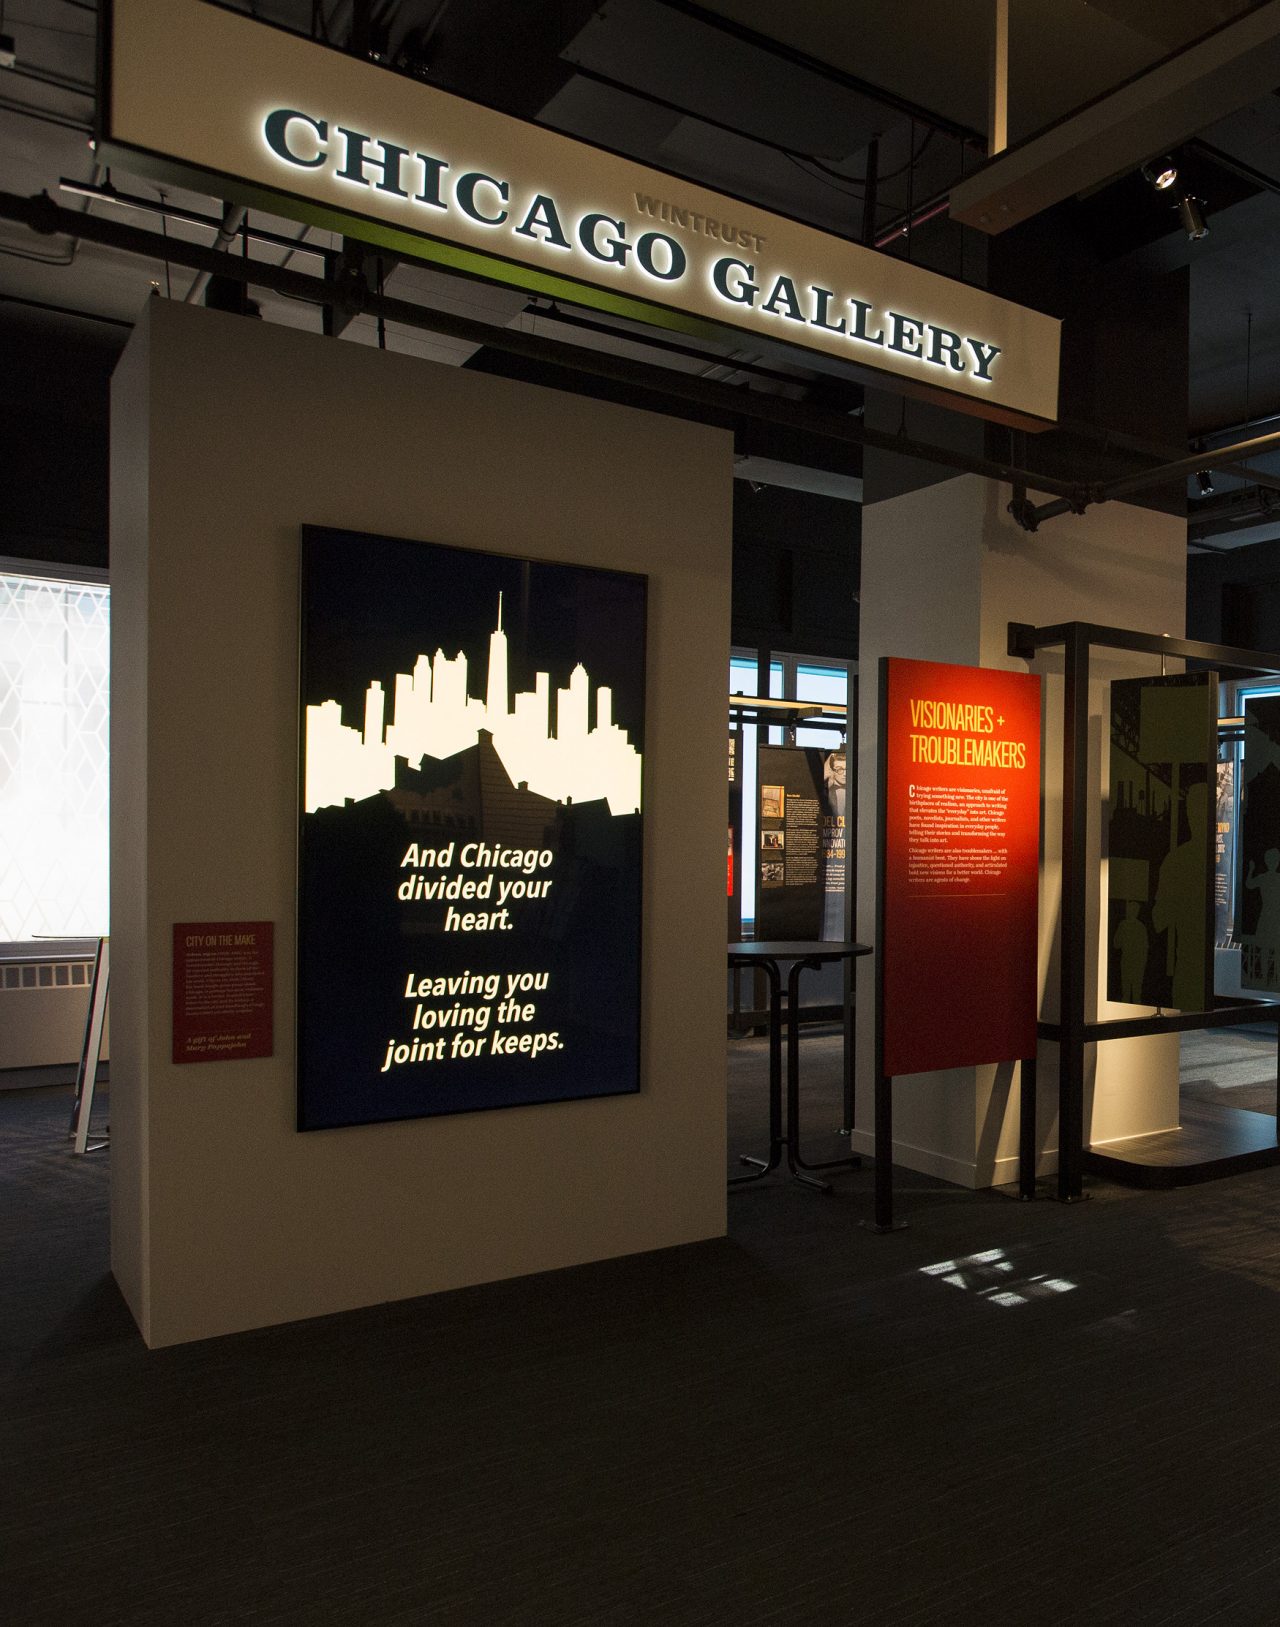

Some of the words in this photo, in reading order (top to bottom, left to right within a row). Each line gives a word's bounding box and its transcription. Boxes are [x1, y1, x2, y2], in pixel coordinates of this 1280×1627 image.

[633, 191, 767, 254] WINTRUST
[262, 108, 686, 283] CHICAGO
[710, 256, 1001, 383] GALLERY
[910, 698, 994, 734] VISIONARIES
[910, 734, 1026, 769] TROUBLEMAKERS
[400, 842, 455, 868] And
[459, 842, 554, 874] Chicago
[397, 873, 494, 901] divided
[495, 880, 553, 906] your
[444, 906, 514, 932] heart.
[186, 935, 204, 947] CITY
[206, 935, 217, 946] ON
[218, 934, 233, 946] THE
[234, 934, 256, 945] MAKE
[404, 970, 500, 1000] Leaving
[504, 972, 550, 998] you
[412, 1002, 491, 1032] loving
[497, 998, 536, 1024] the
[380, 1038, 447, 1072] joint
[450, 1032, 487, 1059] for
[490, 1030, 565, 1058] keeps.
